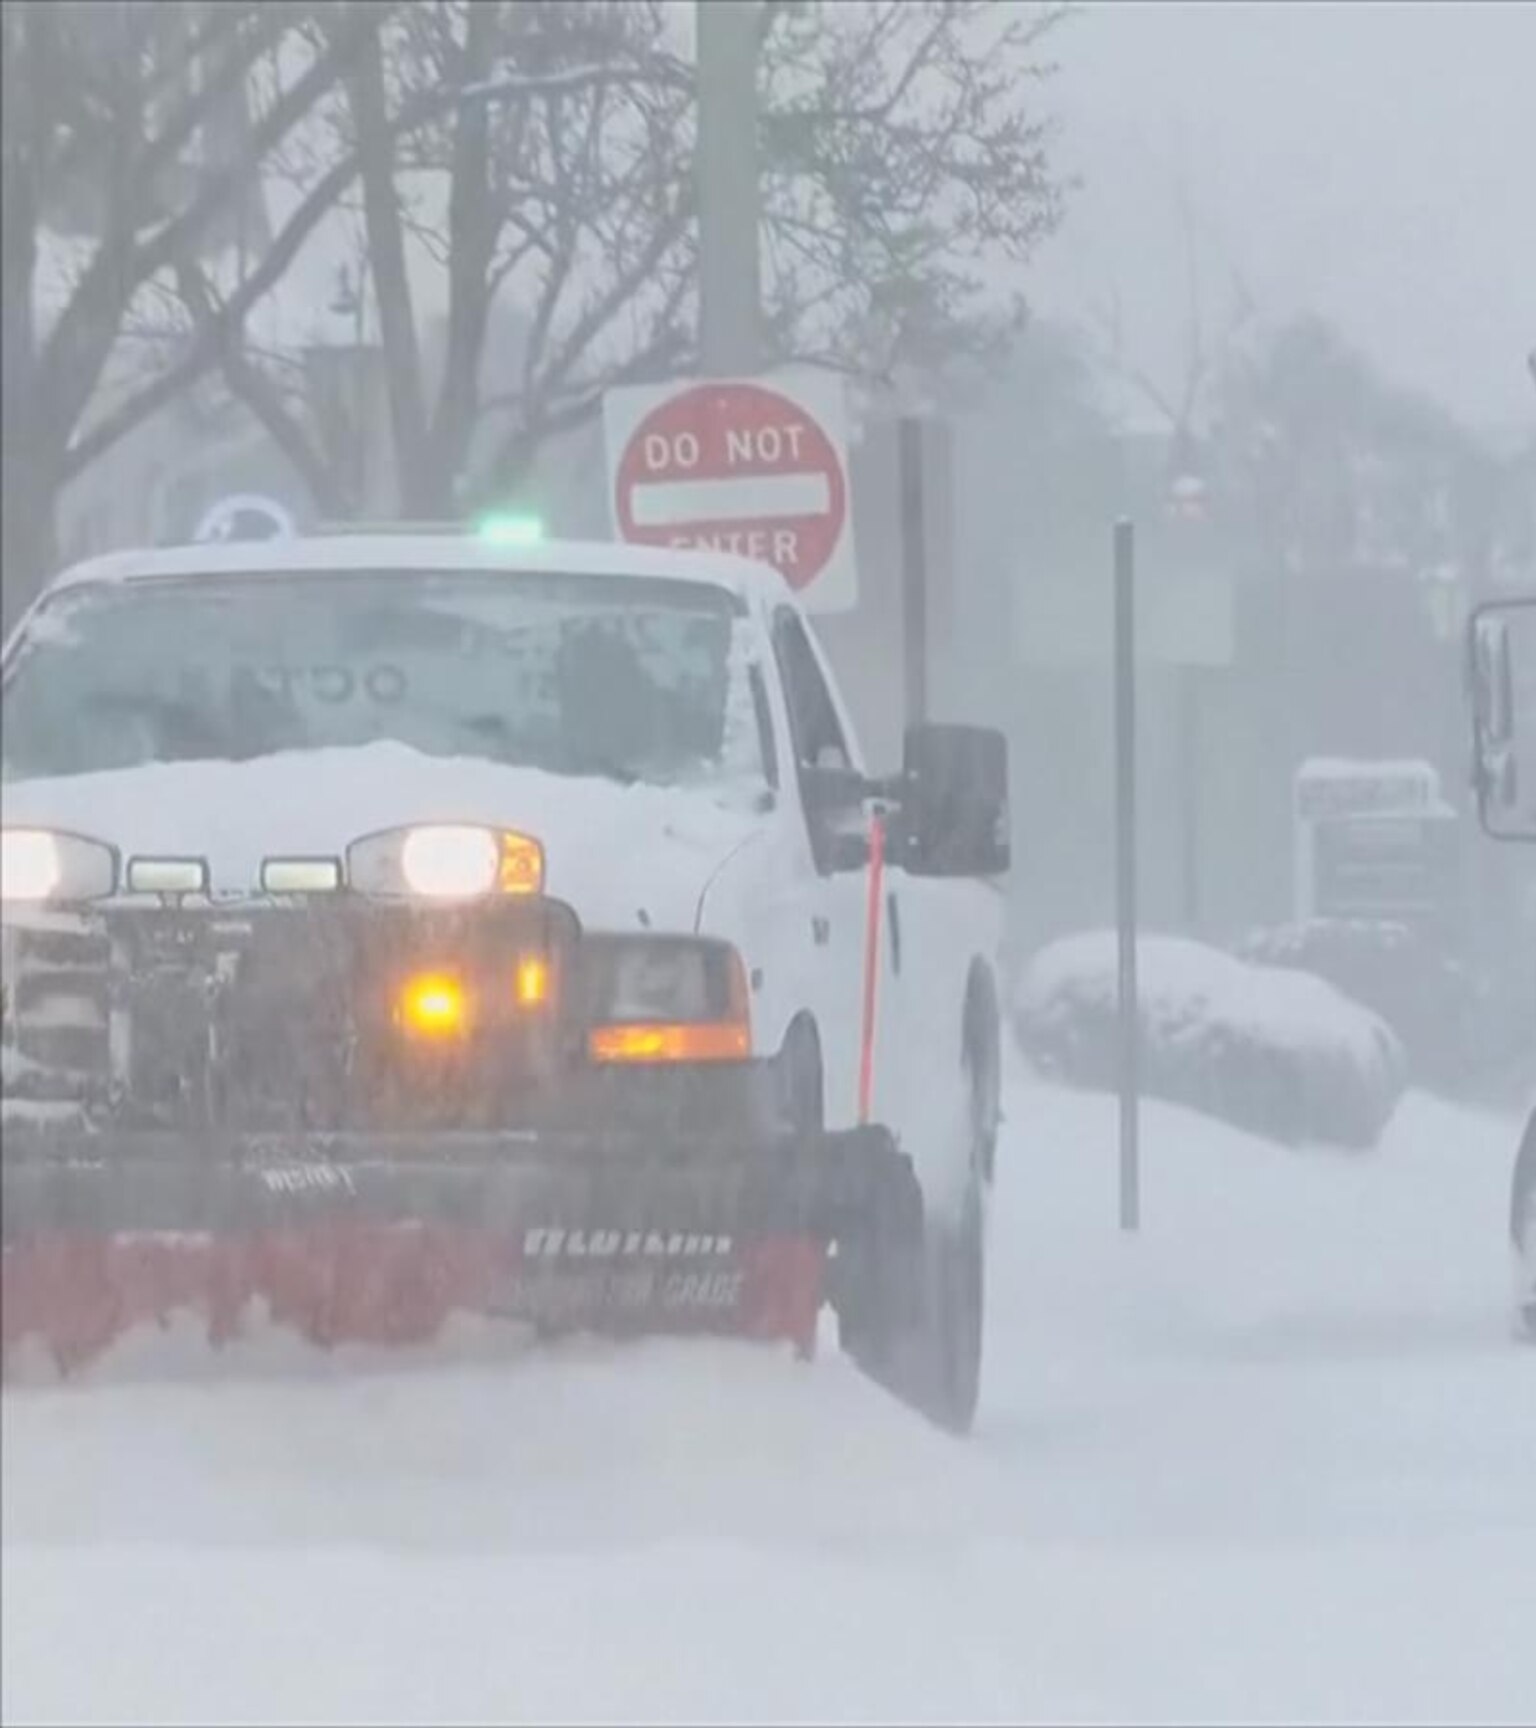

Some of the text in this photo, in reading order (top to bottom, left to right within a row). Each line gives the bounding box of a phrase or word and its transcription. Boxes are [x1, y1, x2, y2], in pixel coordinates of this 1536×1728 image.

[644, 425, 805, 470] DO NOT
[669, 529, 799, 565] TER
